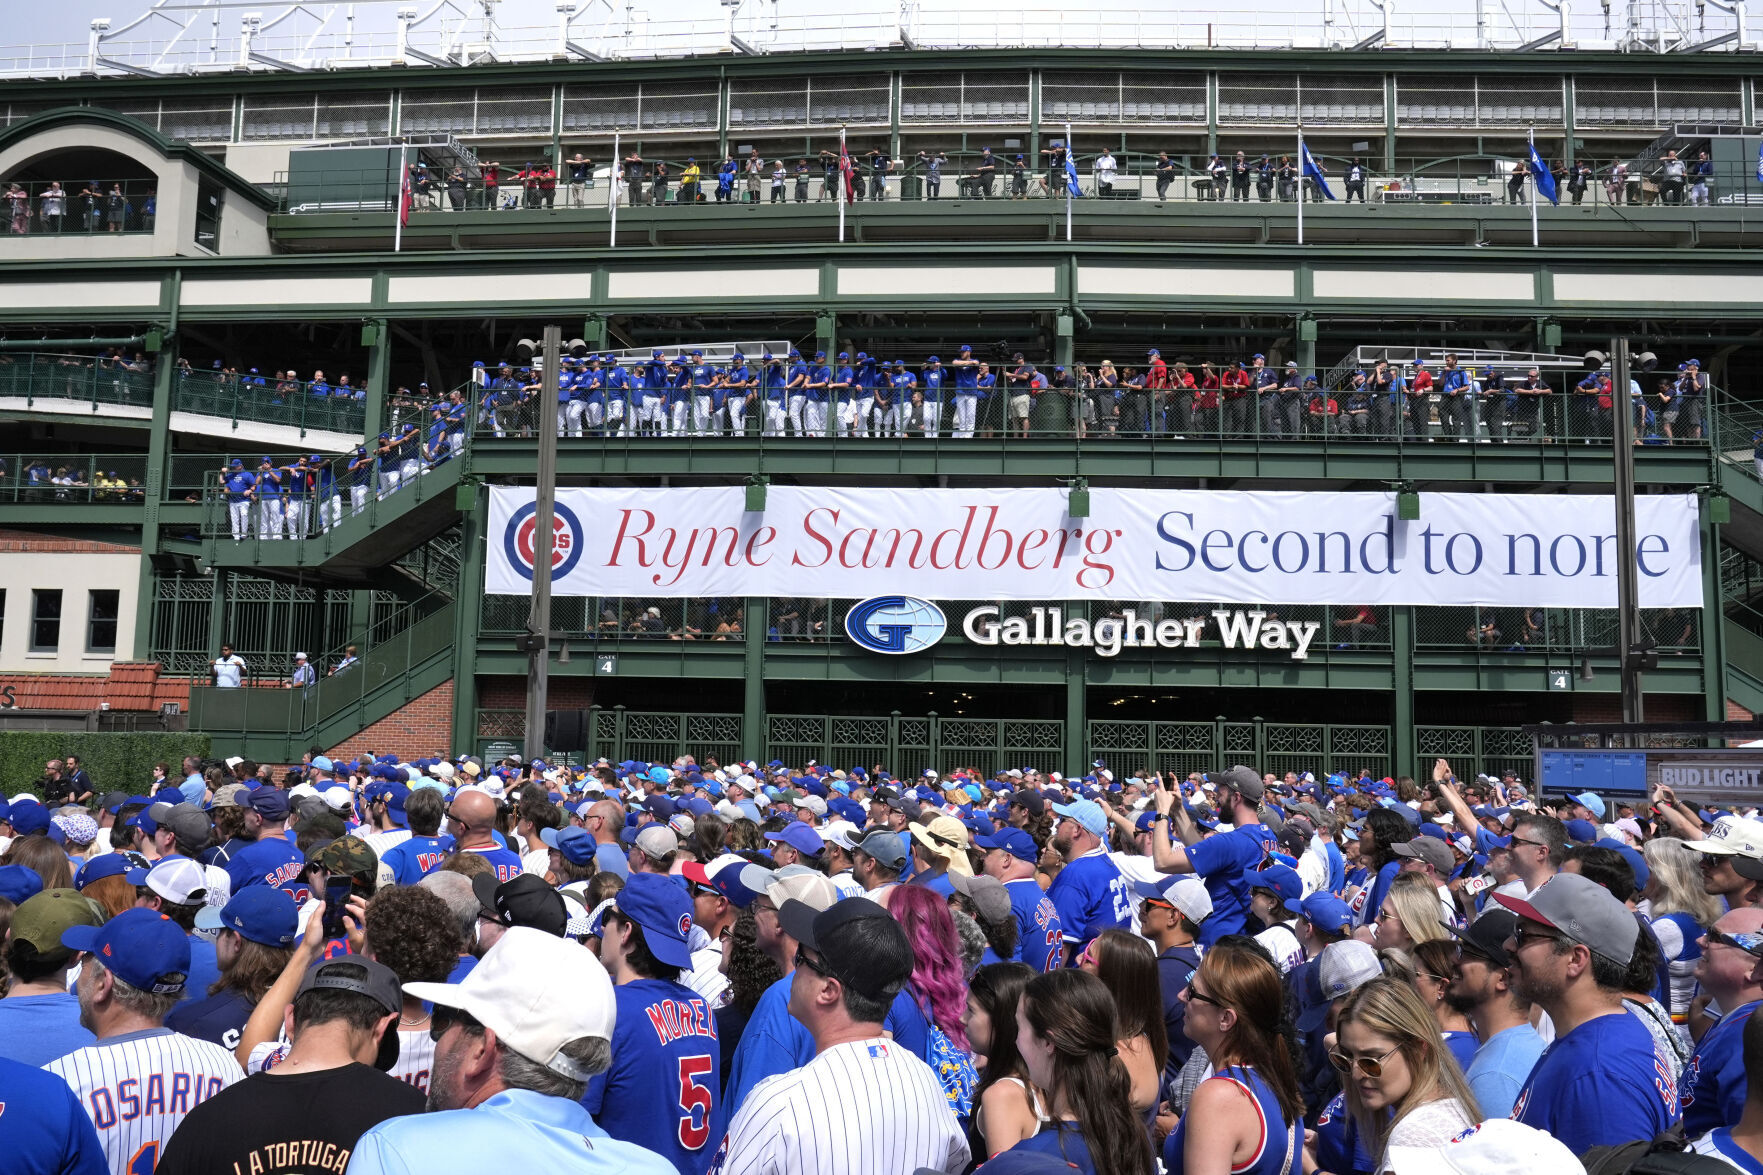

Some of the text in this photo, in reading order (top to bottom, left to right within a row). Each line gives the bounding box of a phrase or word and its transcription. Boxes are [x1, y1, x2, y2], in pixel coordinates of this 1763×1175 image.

[601, 505, 1123, 589] Ryne Sandberg
[1155, 511, 1671, 577] Second to none
[963, 605, 1320, 659] Gallagher Way
[601, 661, 612, 673] 4
[1554, 676, 1566, 688] 4
[1662, 768, 1760, 788] BUD LIGHT
[645, 999, 718, 1046] MOREL
[678, 1054, 712, 1150] 5
[264, 1140, 350, 1175] TORTUGA
